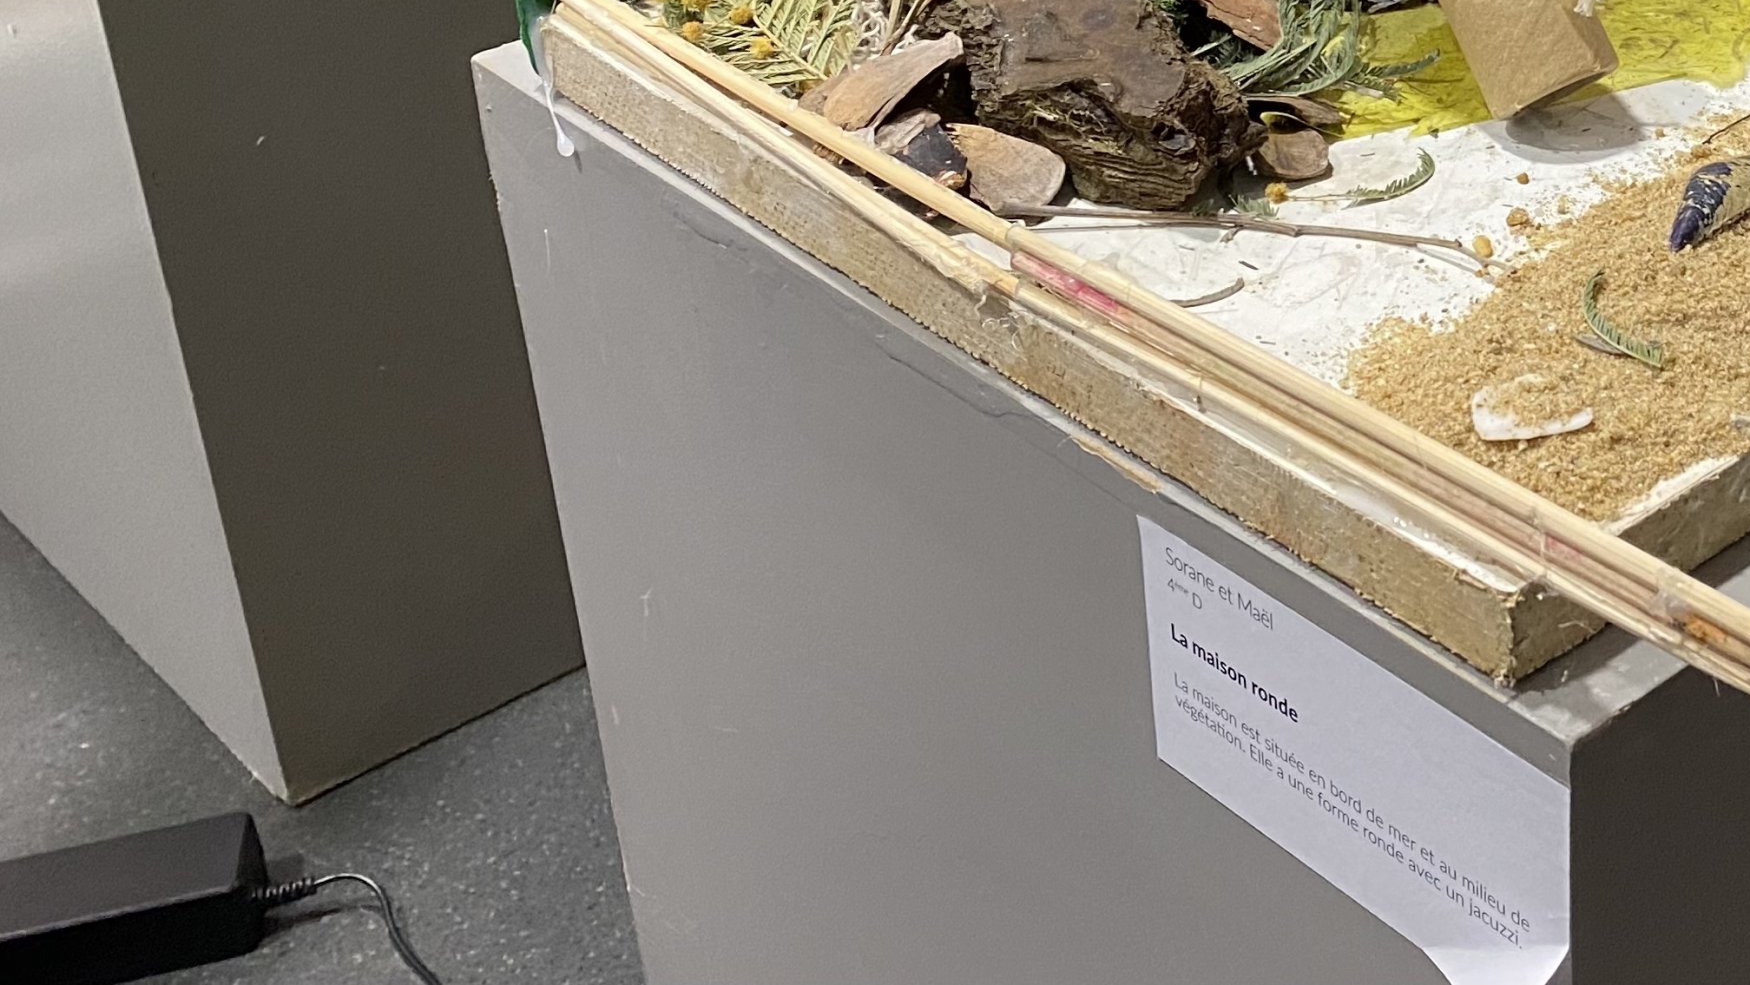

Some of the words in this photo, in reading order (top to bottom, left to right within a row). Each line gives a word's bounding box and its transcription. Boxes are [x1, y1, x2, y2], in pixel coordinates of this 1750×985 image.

[1165, 546, 1215, 593] Sorane
[1218, 585, 1234, 606] et
[1237, 591, 1274, 631] Maël
[1191, 592, 1203, 610] D
[1170, 622, 1189, 649] La
[1192, 641, 1247, 689] maison
[1251, 681, 1299, 723] ronde
[1174, 671, 1189, 694] La
[1192, 688, 1238, 728] maison
[1241, 722, 1262, 745] est
[1264, 738, 1305, 775] située
[1308, 769, 1326, 790] en
[1329, 779, 1362, 814] bord
[1366, 808, 1384, 829] de
[1388, 823, 1417, 851] mer
[1420, 846, 1436, 866] et
[1439, 860, 1458, 881] au
[1461, 875, 1507, 916] milieu
[1510, 909, 1531, 933] de
[1174, 694, 1246, 754] végétation.
[1249, 743, 1274, 772] Elle
[1276, 766, 1285, 780] a
[1288, 773, 1314, 801] une
[1317, 791, 1359, 833] forme
[1362, 827, 1405, 864] ronde
[1408, 858, 1442, 892] avec
[1445, 884, 1465, 908] un
[1468, 897, 1523, 950] jacuzzi.
